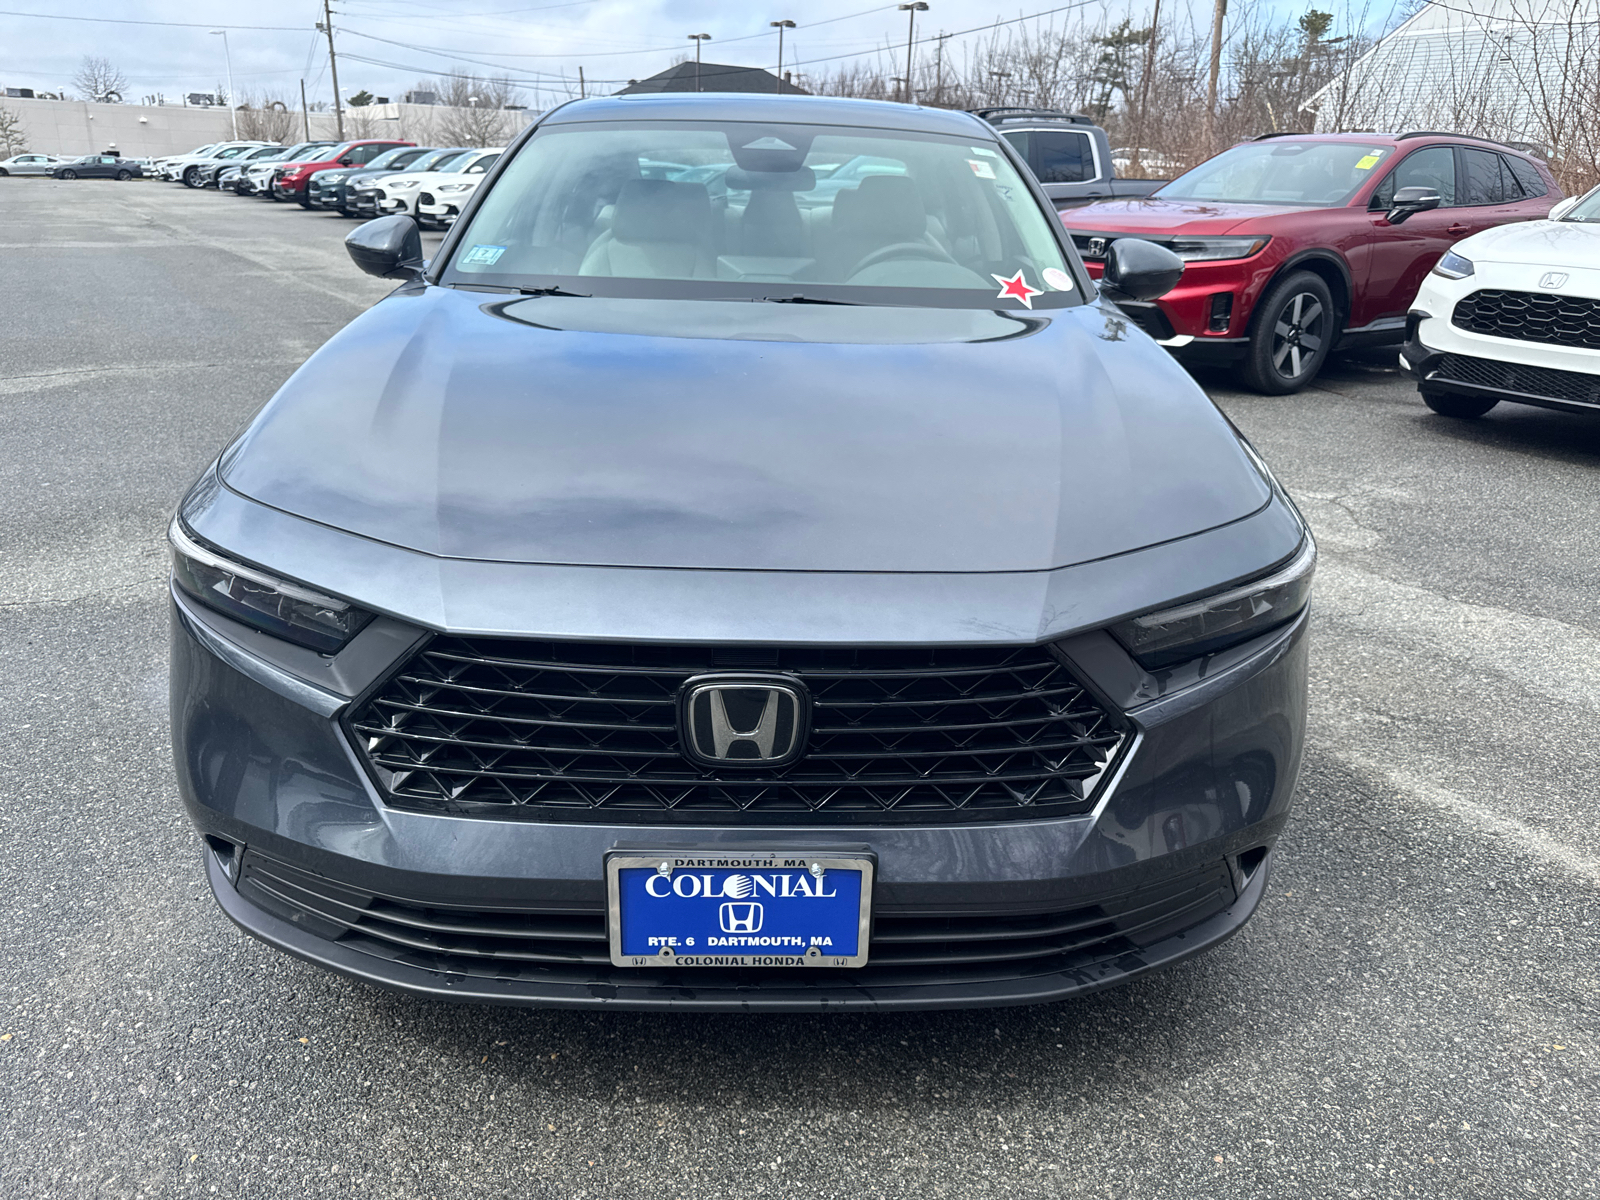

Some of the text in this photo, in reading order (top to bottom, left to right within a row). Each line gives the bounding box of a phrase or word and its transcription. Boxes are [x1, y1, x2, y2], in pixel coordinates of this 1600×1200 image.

[783, 859, 807, 867] MA
[645, 874, 837, 899] COLONIAL
[648, 936, 833, 948] RTE. 6 DARTMOUTH, MA
[675, 956, 805, 966] COLONIAL HONDA
